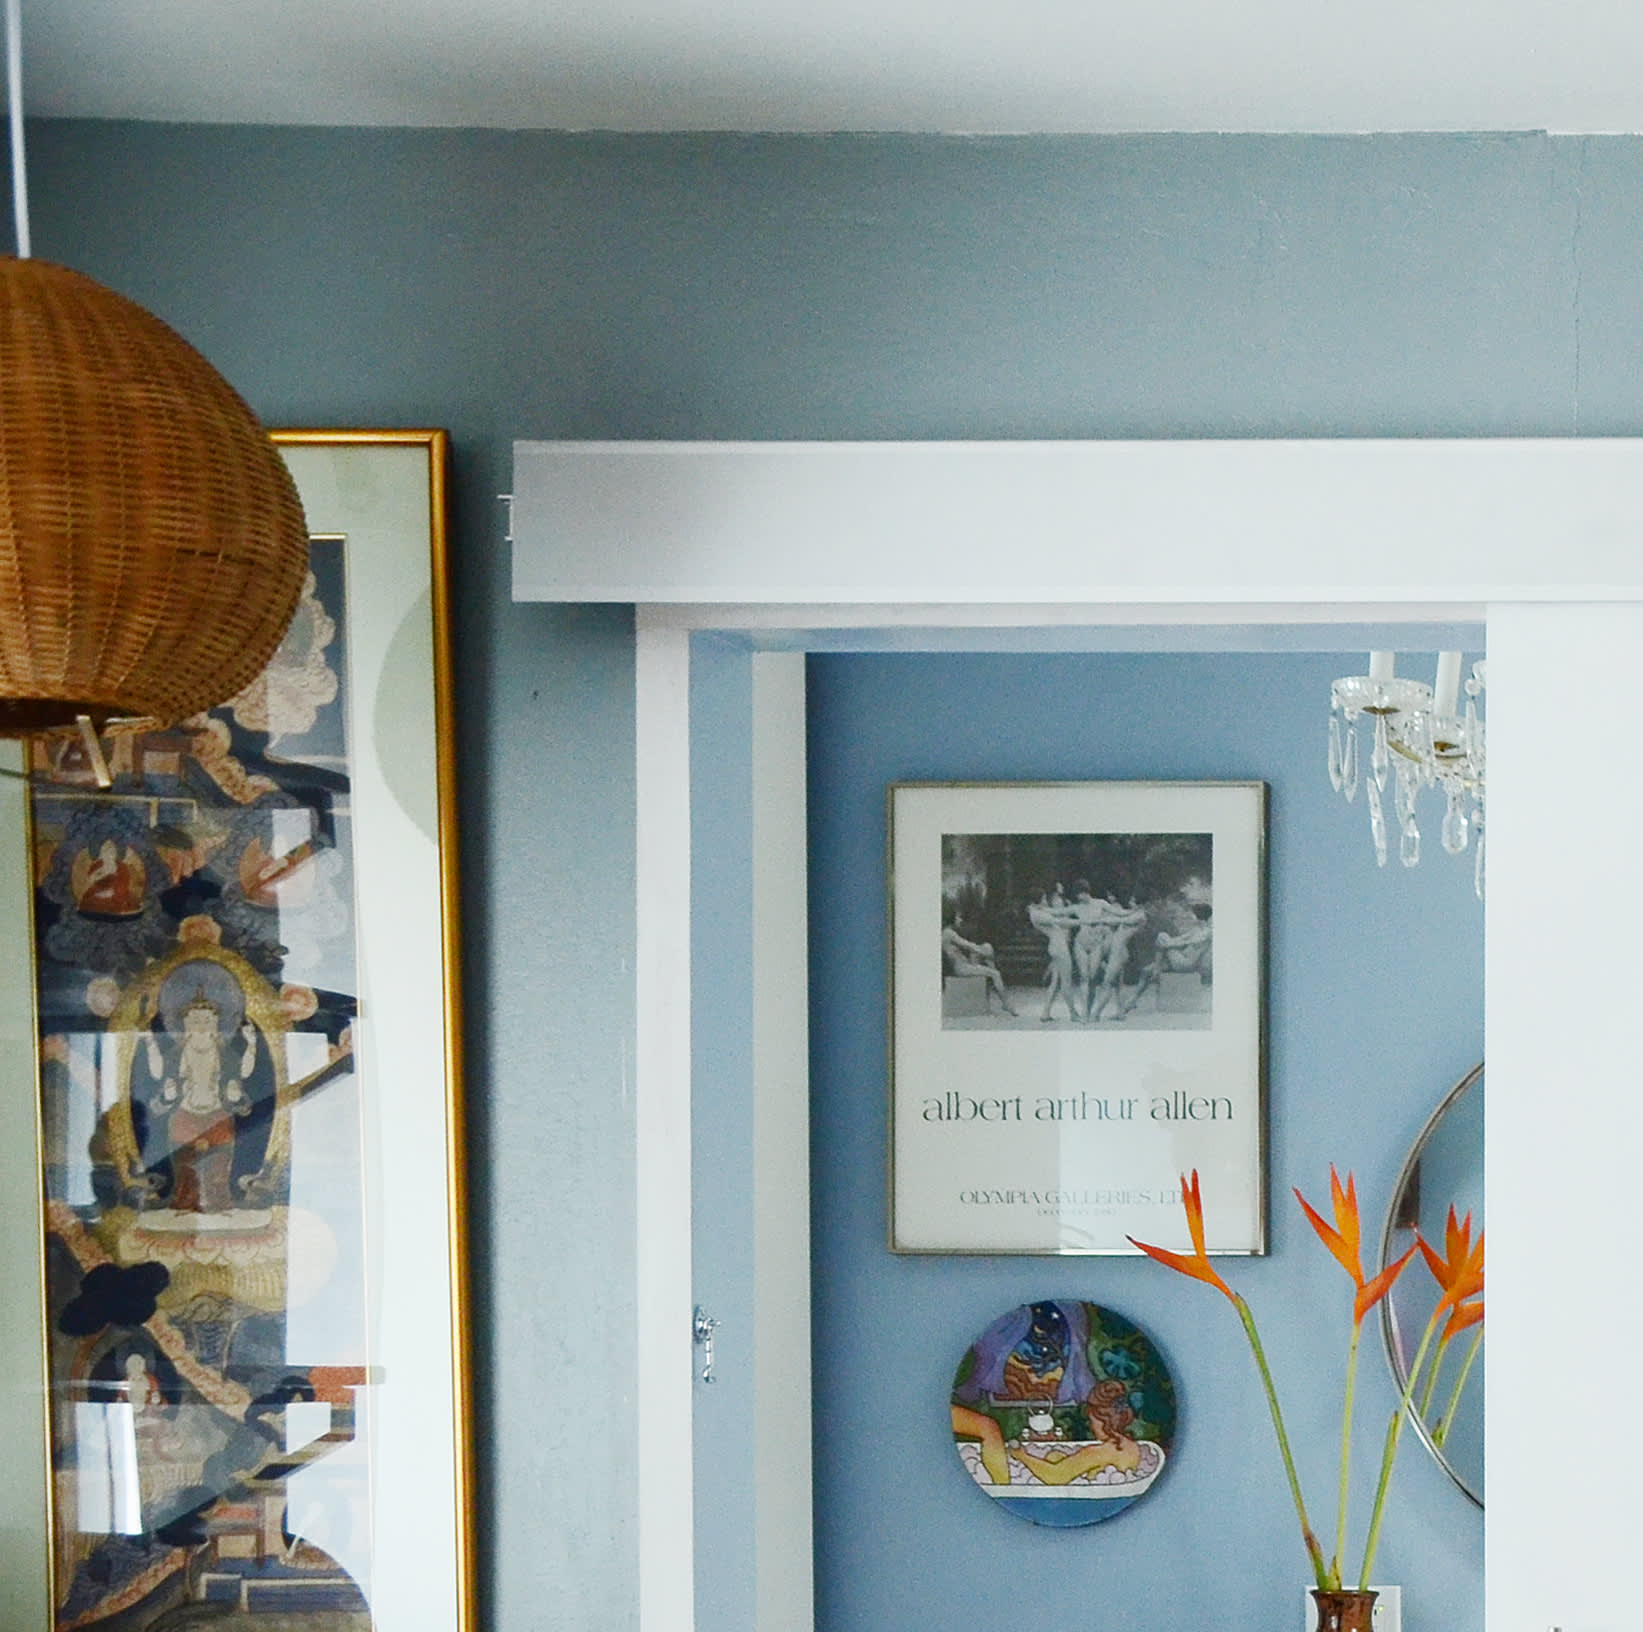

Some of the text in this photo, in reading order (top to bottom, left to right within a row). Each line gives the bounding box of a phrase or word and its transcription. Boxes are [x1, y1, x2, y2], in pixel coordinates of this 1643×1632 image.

[921, 1090, 1234, 1122] albert arthur allen
